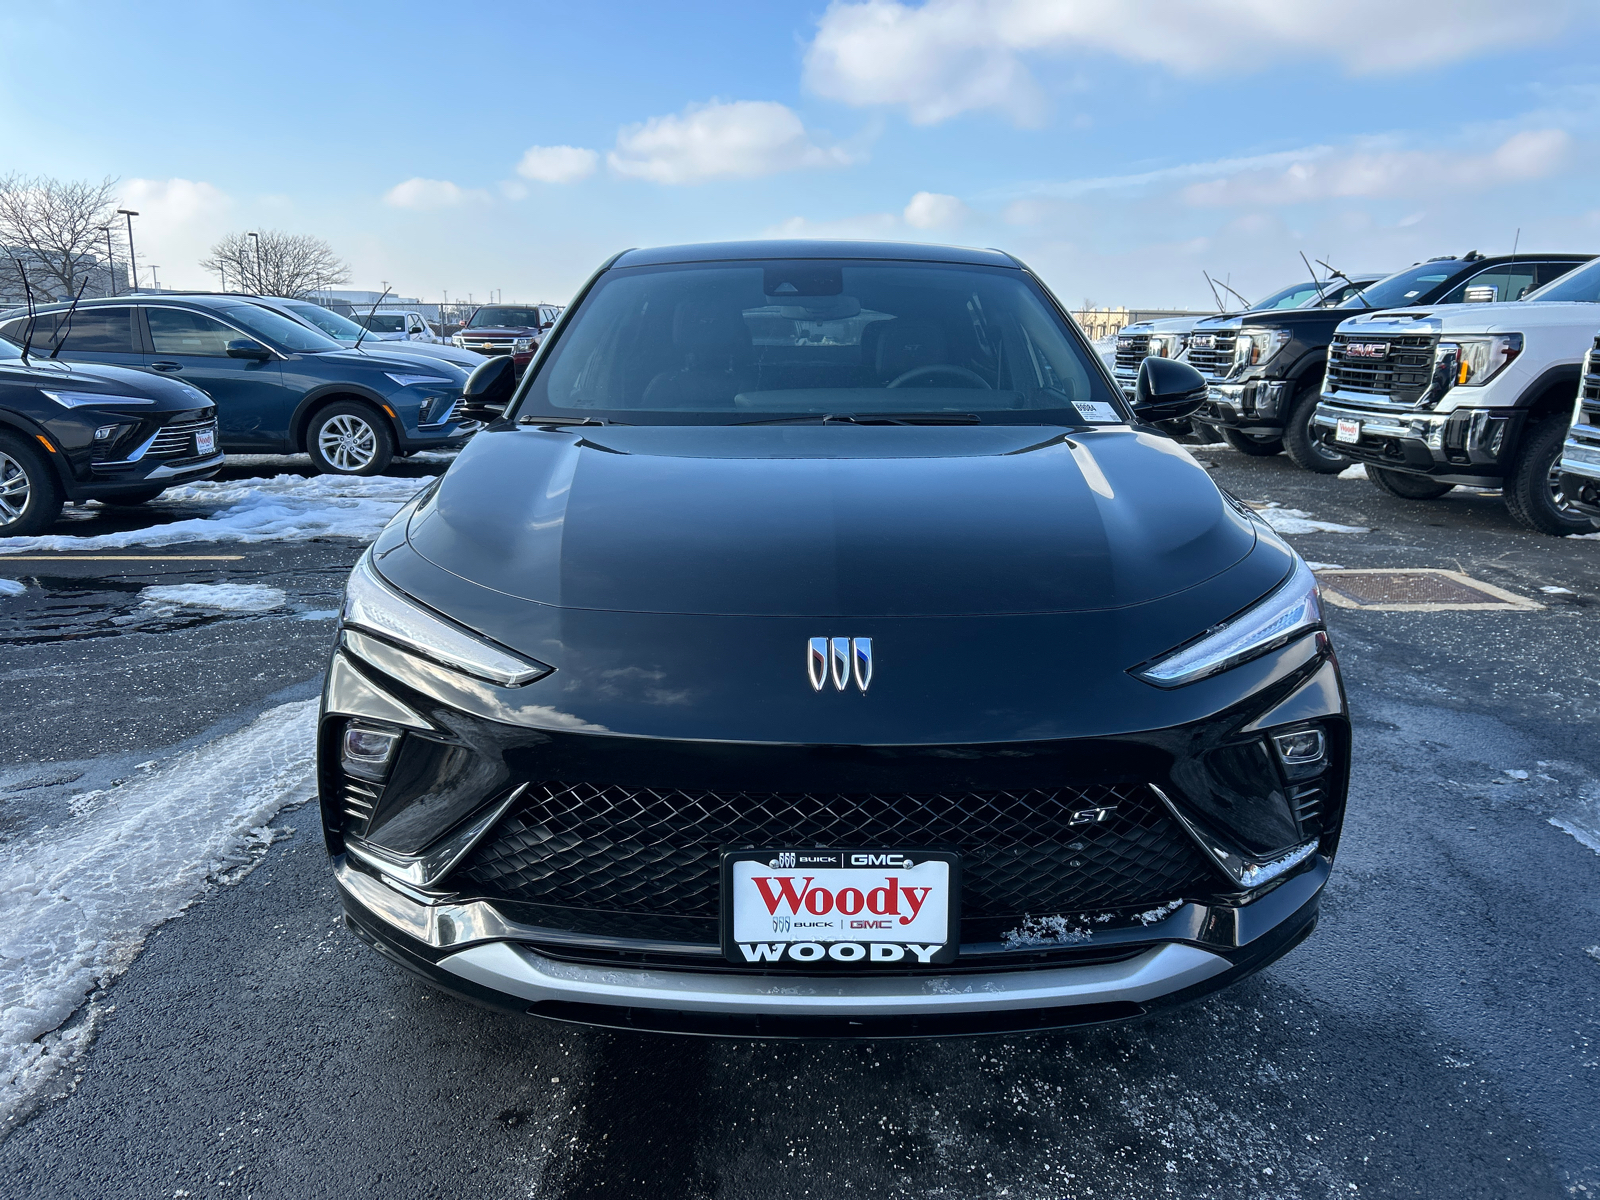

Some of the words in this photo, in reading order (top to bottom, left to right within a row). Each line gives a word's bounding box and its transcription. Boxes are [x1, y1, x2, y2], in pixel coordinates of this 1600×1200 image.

[1346, 343, 1386, 357] GMC
[850, 854, 904, 866] GMC
[750, 877, 932, 925] Woody
[850, 920, 893, 930] GMC
[738, 942, 943, 964] WOODY
